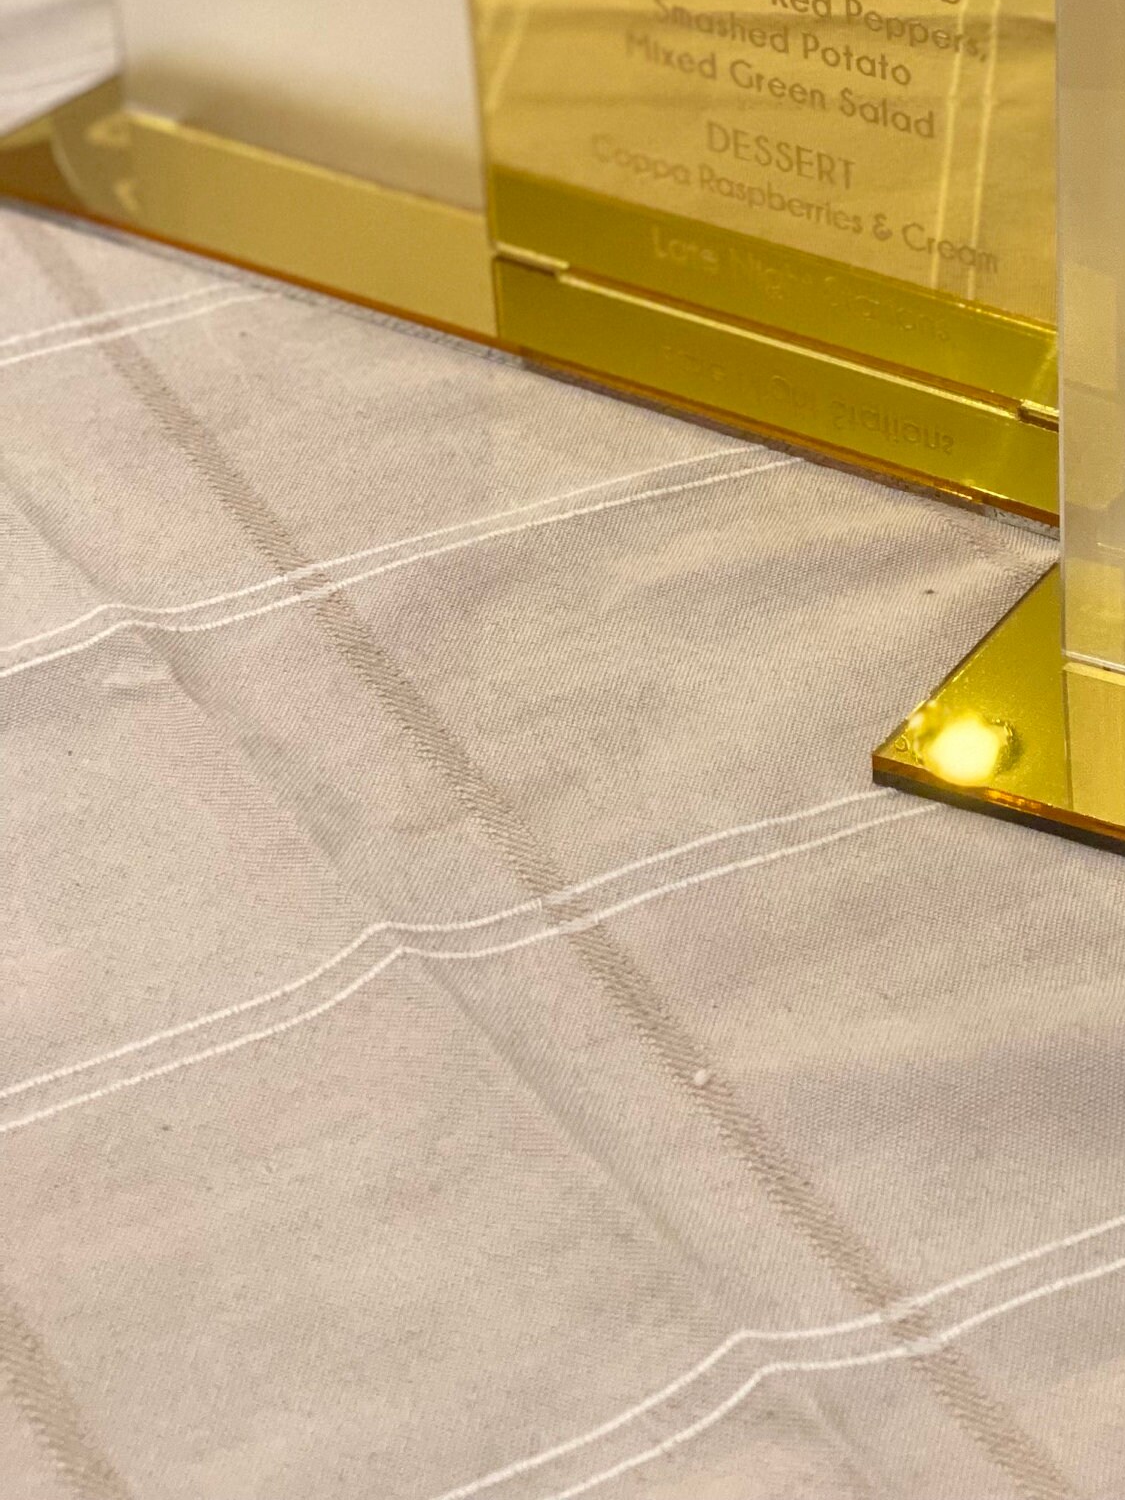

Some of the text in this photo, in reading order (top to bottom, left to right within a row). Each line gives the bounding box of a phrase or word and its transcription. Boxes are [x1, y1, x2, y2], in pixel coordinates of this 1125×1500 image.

[802, 31, 912, 86] Potato
[730, 59, 827, 110] Green
[840, 88, 935, 138] Salad
[706, 121, 855, 189] DESSERT
[700, 166, 863, 234] Raspberries
[873, 214, 893, 241] &
[901, 223, 998, 274] Cream
